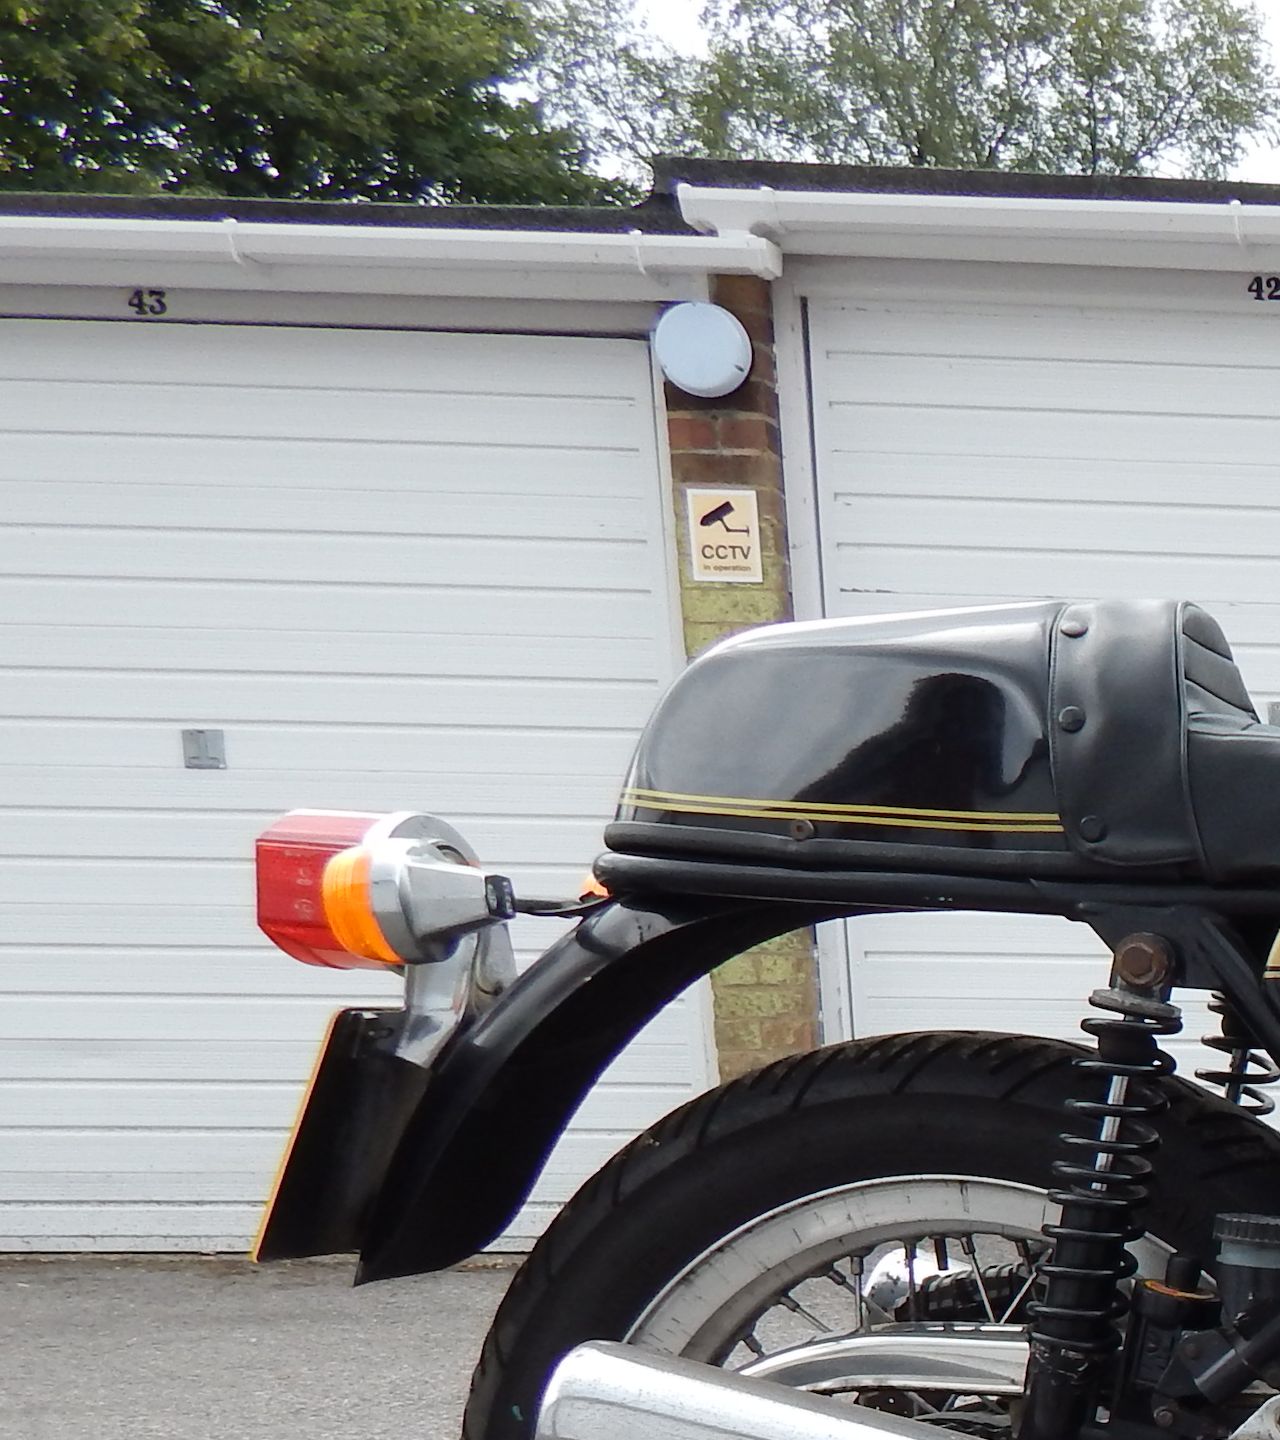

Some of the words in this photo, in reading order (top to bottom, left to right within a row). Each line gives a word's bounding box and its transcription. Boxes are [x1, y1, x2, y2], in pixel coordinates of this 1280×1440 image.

[128, 287, 168, 316] 43
[701, 544, 751, 560] CCTV
[713, 564, 752, 572] operation
